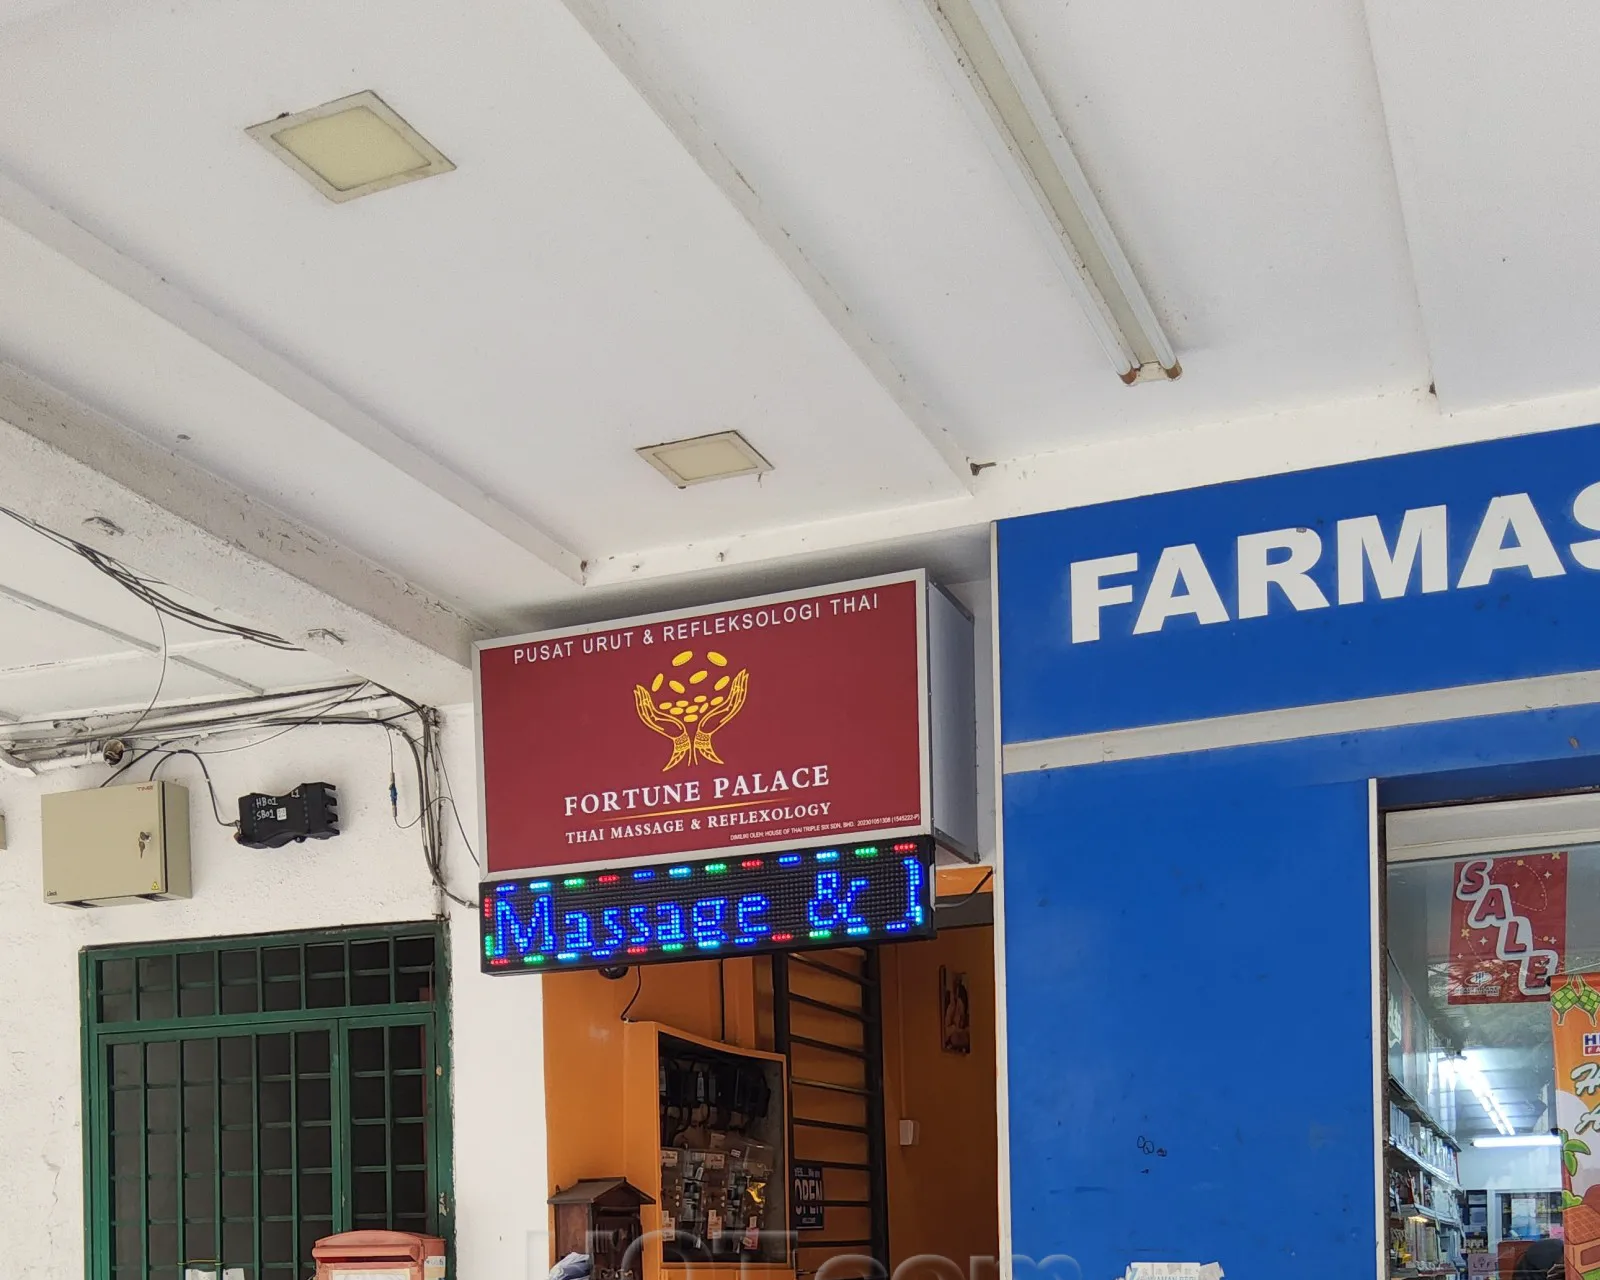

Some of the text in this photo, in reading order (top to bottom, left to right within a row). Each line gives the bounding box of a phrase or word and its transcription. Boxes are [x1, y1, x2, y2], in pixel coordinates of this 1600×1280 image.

[514, 593, 878, 665] PUSAT URUT & REFLEKSOLOGI THAI
[255, 798, 278, 809] HB01
[564, 765, 830, 816] FORTUNE PALACE
[256, 809, 276, 820] SB01
[565, 802, 832, 844] THAI MASSAGE & REFLEXOLOGY
[764, 830, 782, 838] HOUSE
[783, 828, 790, 836] OF
[791, 826, 803, 834] THAI
[803, 824, 821, 832] TRIPLE
[821, 823, 830, 831] SIX
[493, 889, 770, 956] Massage
[806, 871, 869, 928] &
[1456, 859, 1559, 996] SALE
[794, 1178, 823, 1216] OPEN
